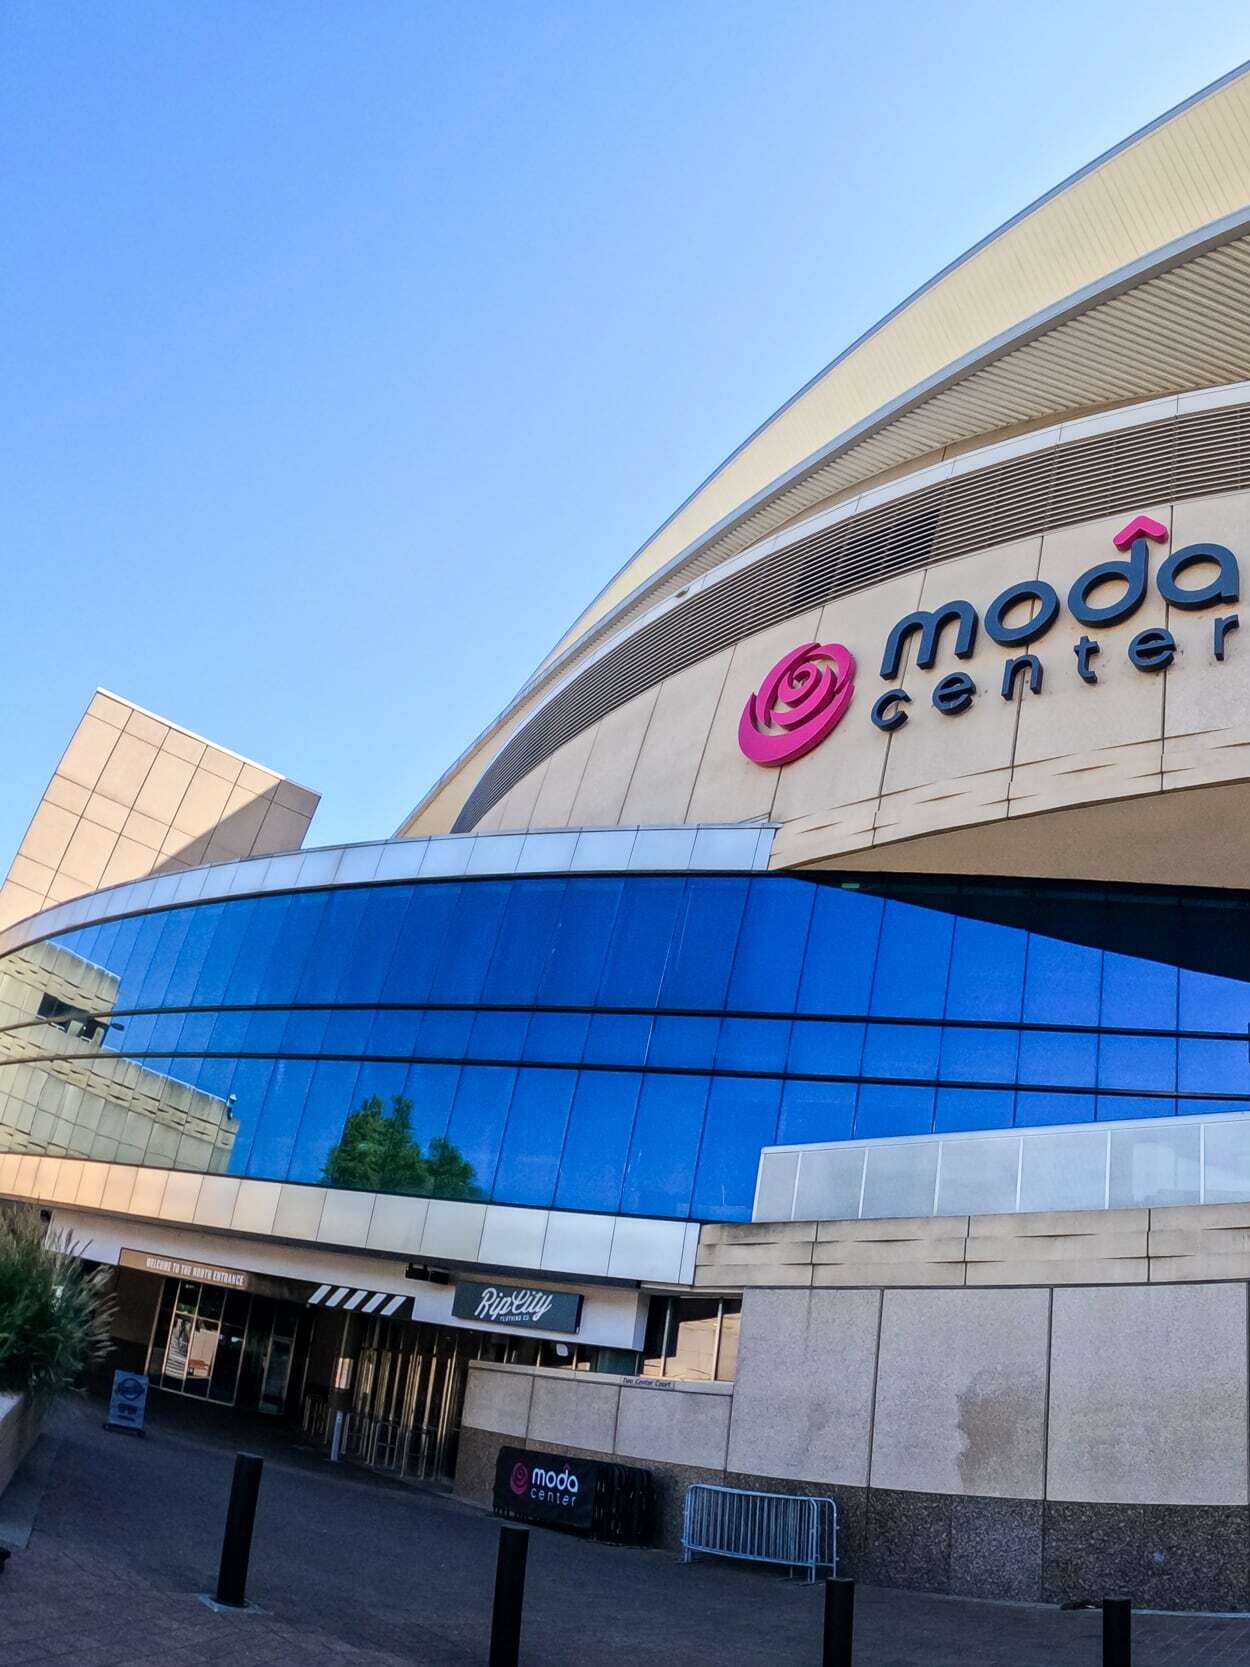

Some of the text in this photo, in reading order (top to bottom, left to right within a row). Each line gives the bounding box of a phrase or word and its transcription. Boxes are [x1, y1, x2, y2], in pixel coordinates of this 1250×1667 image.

[880, 537, 1240, 680] moda
[870, 613, 1240, 732] center
[145, 1257, 245, 1286] WELCOME TO THE NORTH ENTRANCE
[532, 1468, 579, 1493] moda
[530, 1488, 577, 1507] center
